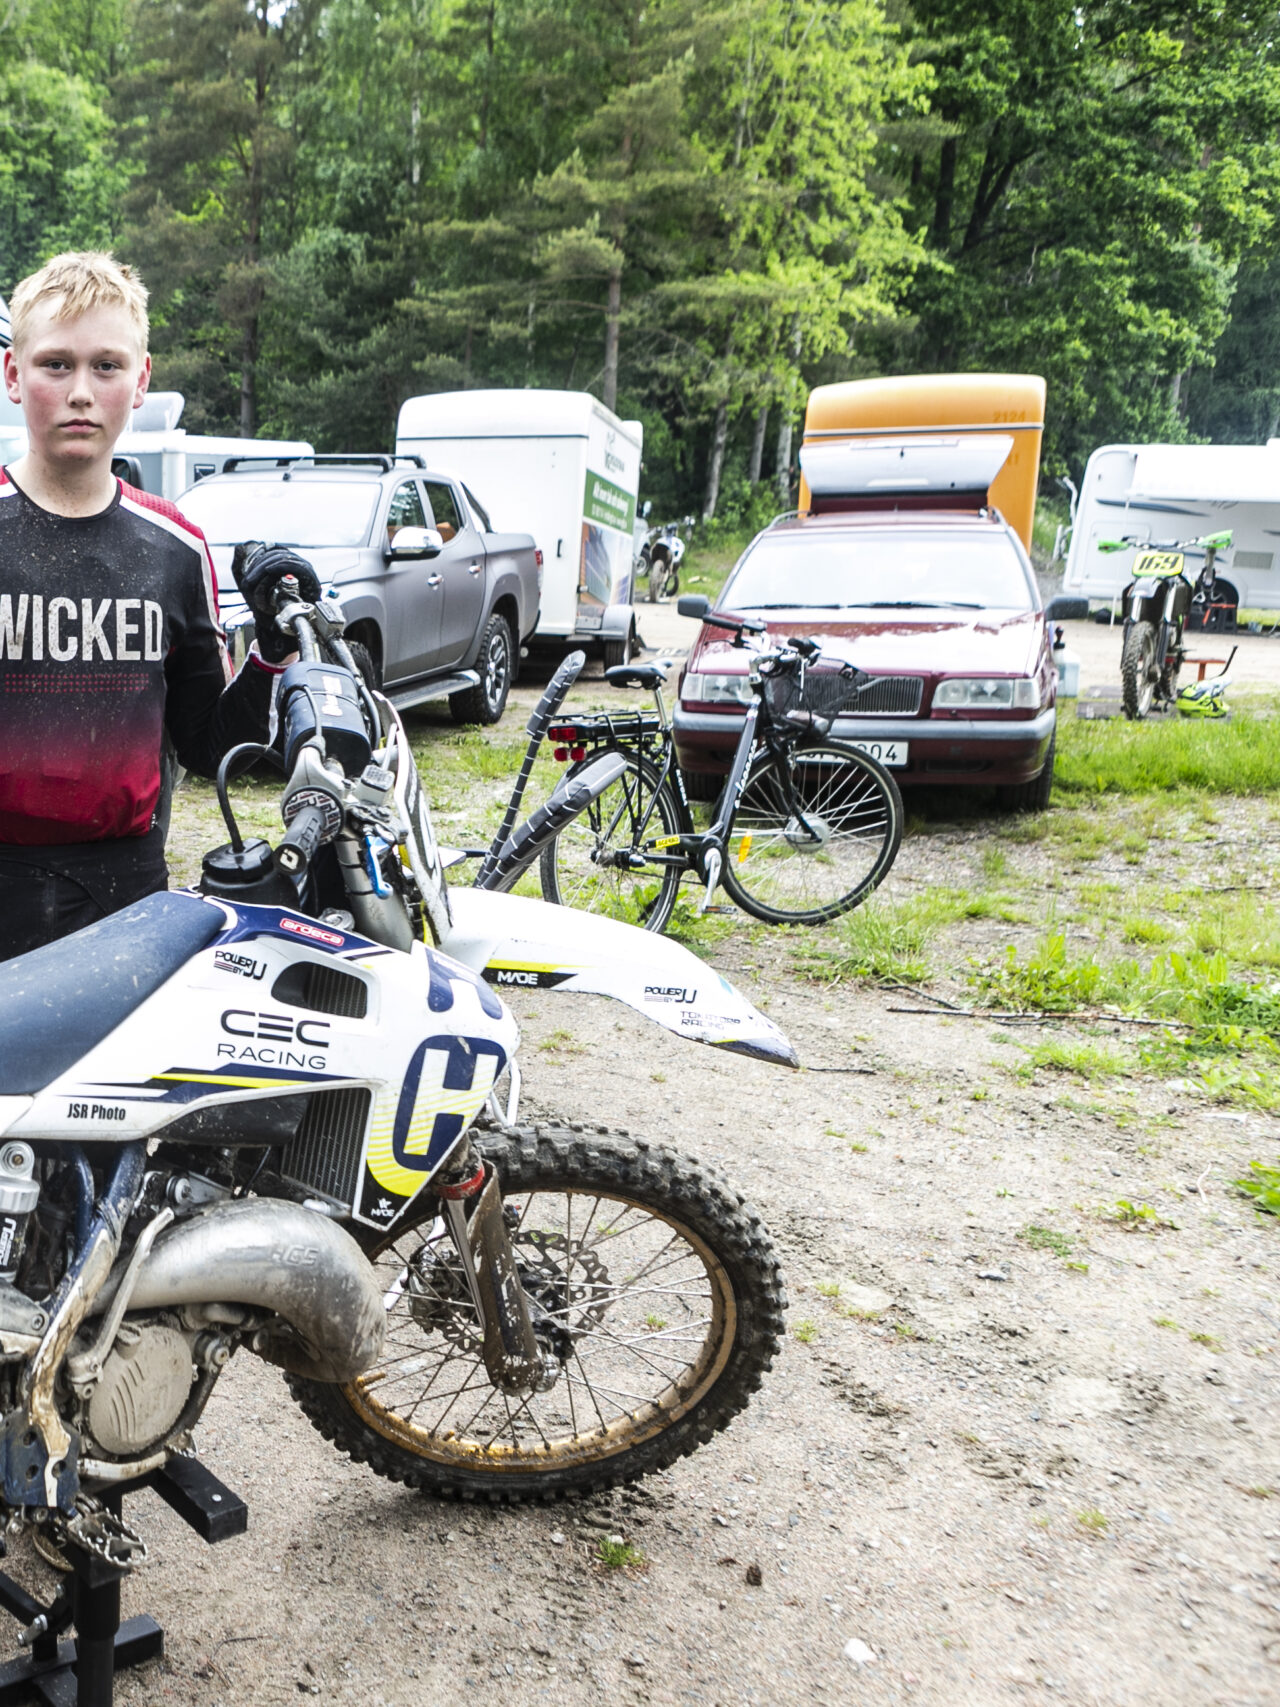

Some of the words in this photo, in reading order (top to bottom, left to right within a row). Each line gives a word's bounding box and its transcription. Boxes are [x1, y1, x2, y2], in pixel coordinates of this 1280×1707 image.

[283, 920, 342, 944] ardeca
[215, 951, 252, 967] POWER
[644, 986, 682, 996] POWER
[220, 1009, 330, 1048] CEC
[217, 1043, 326, 1070] RACING
[67, 1103, 88, 1119] JSR
[91, 1105, 126, 1121] Photo
